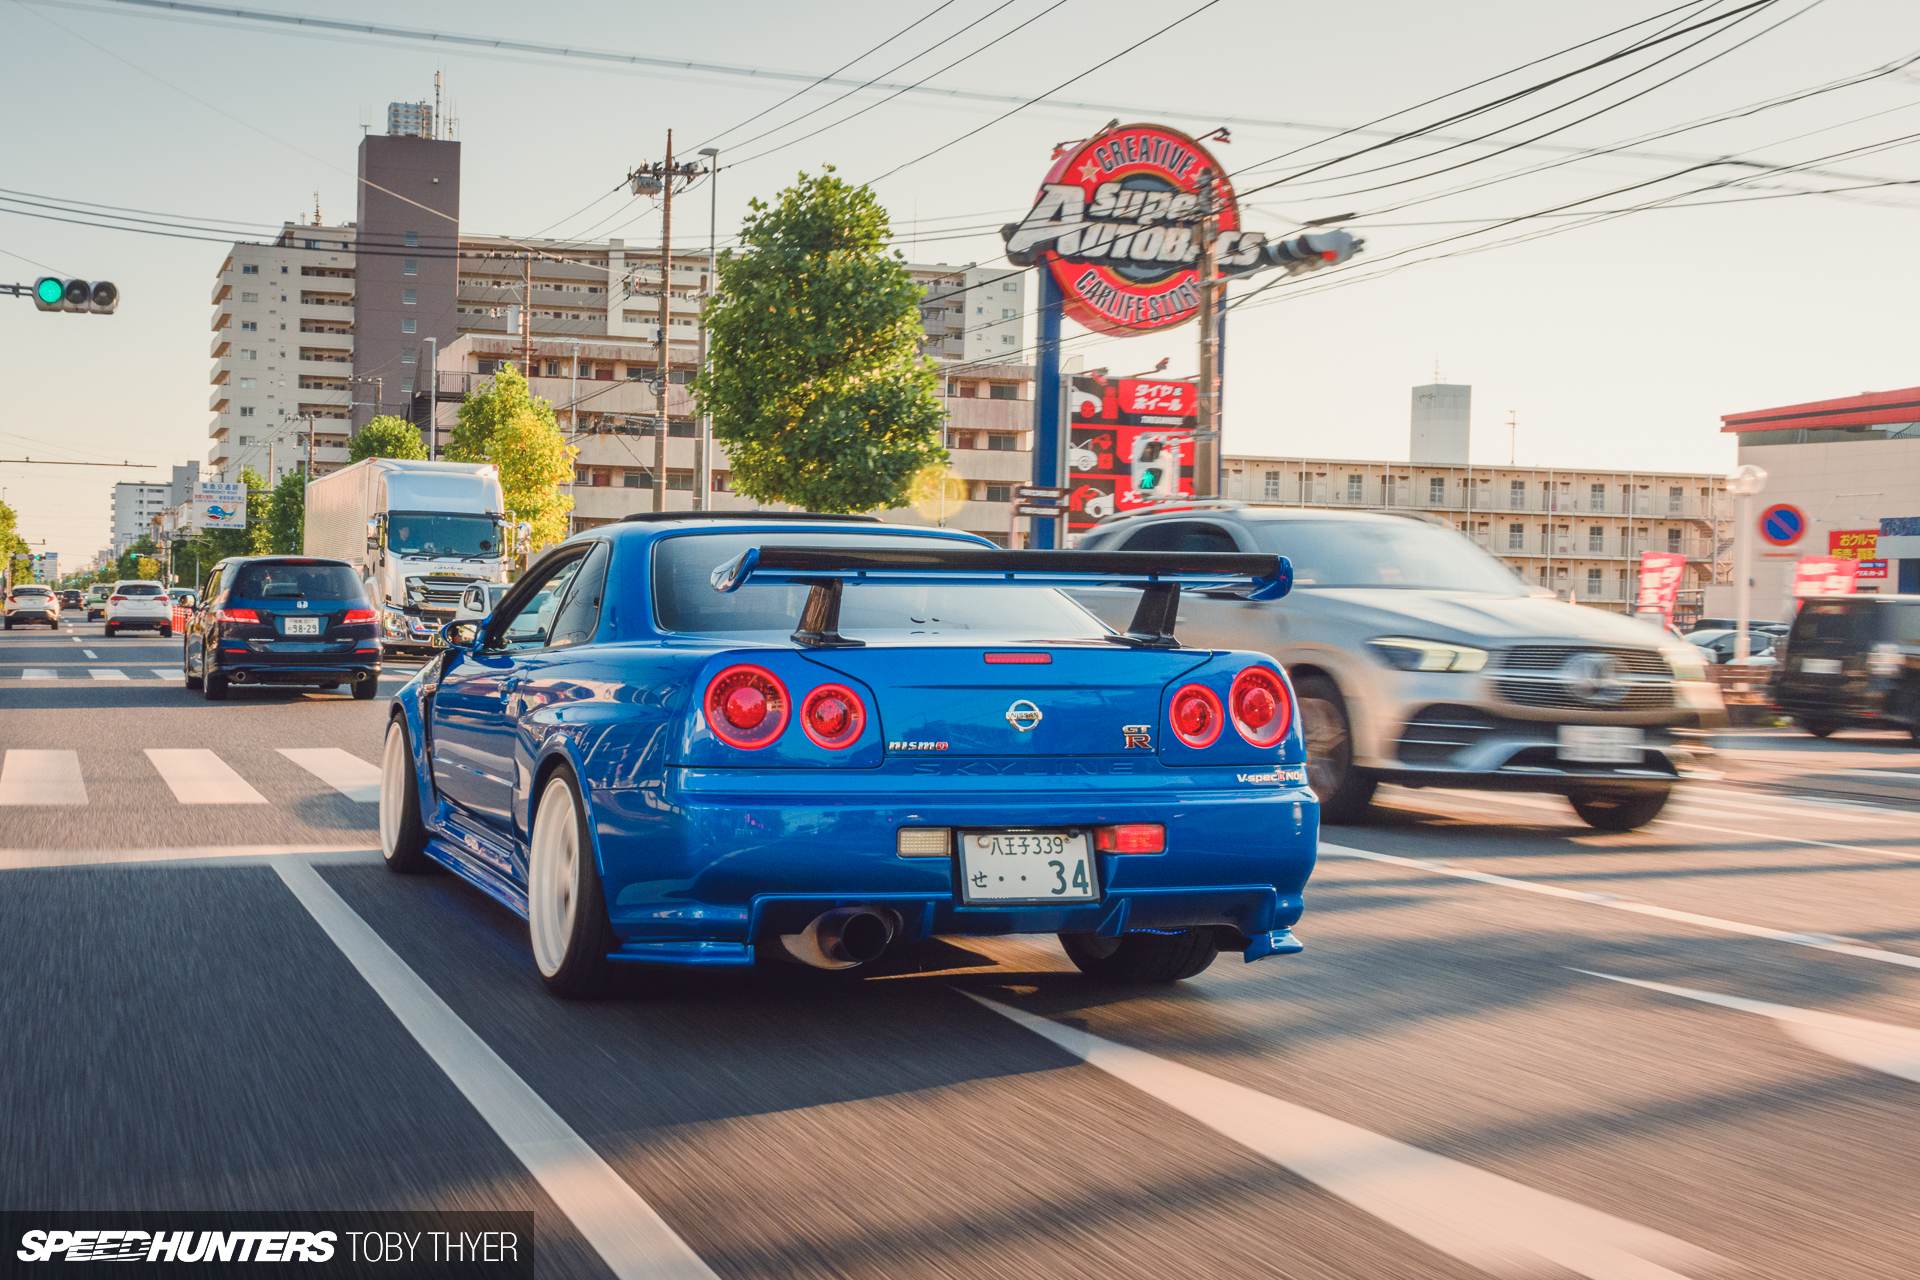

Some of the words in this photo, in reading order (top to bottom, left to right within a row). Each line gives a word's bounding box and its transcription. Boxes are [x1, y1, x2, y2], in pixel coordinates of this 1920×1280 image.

[1096, 135, 1198, 180] CREATIVE
[1074, 269, 1147, 322] CARLIFE
[1132, 397, 1183, 411] ホイール
[1839, 533, 1878, 546] おクルマ
[293, 624, 317, 633] 98-29
[1122, 724, 1151, 734] GT
[889, 741, 948, 750] nismo
[1124, 733, 1152, 749] R
[912, 761, 1134, 776] SKYLINE
[971, 870, 988, 888] せ
